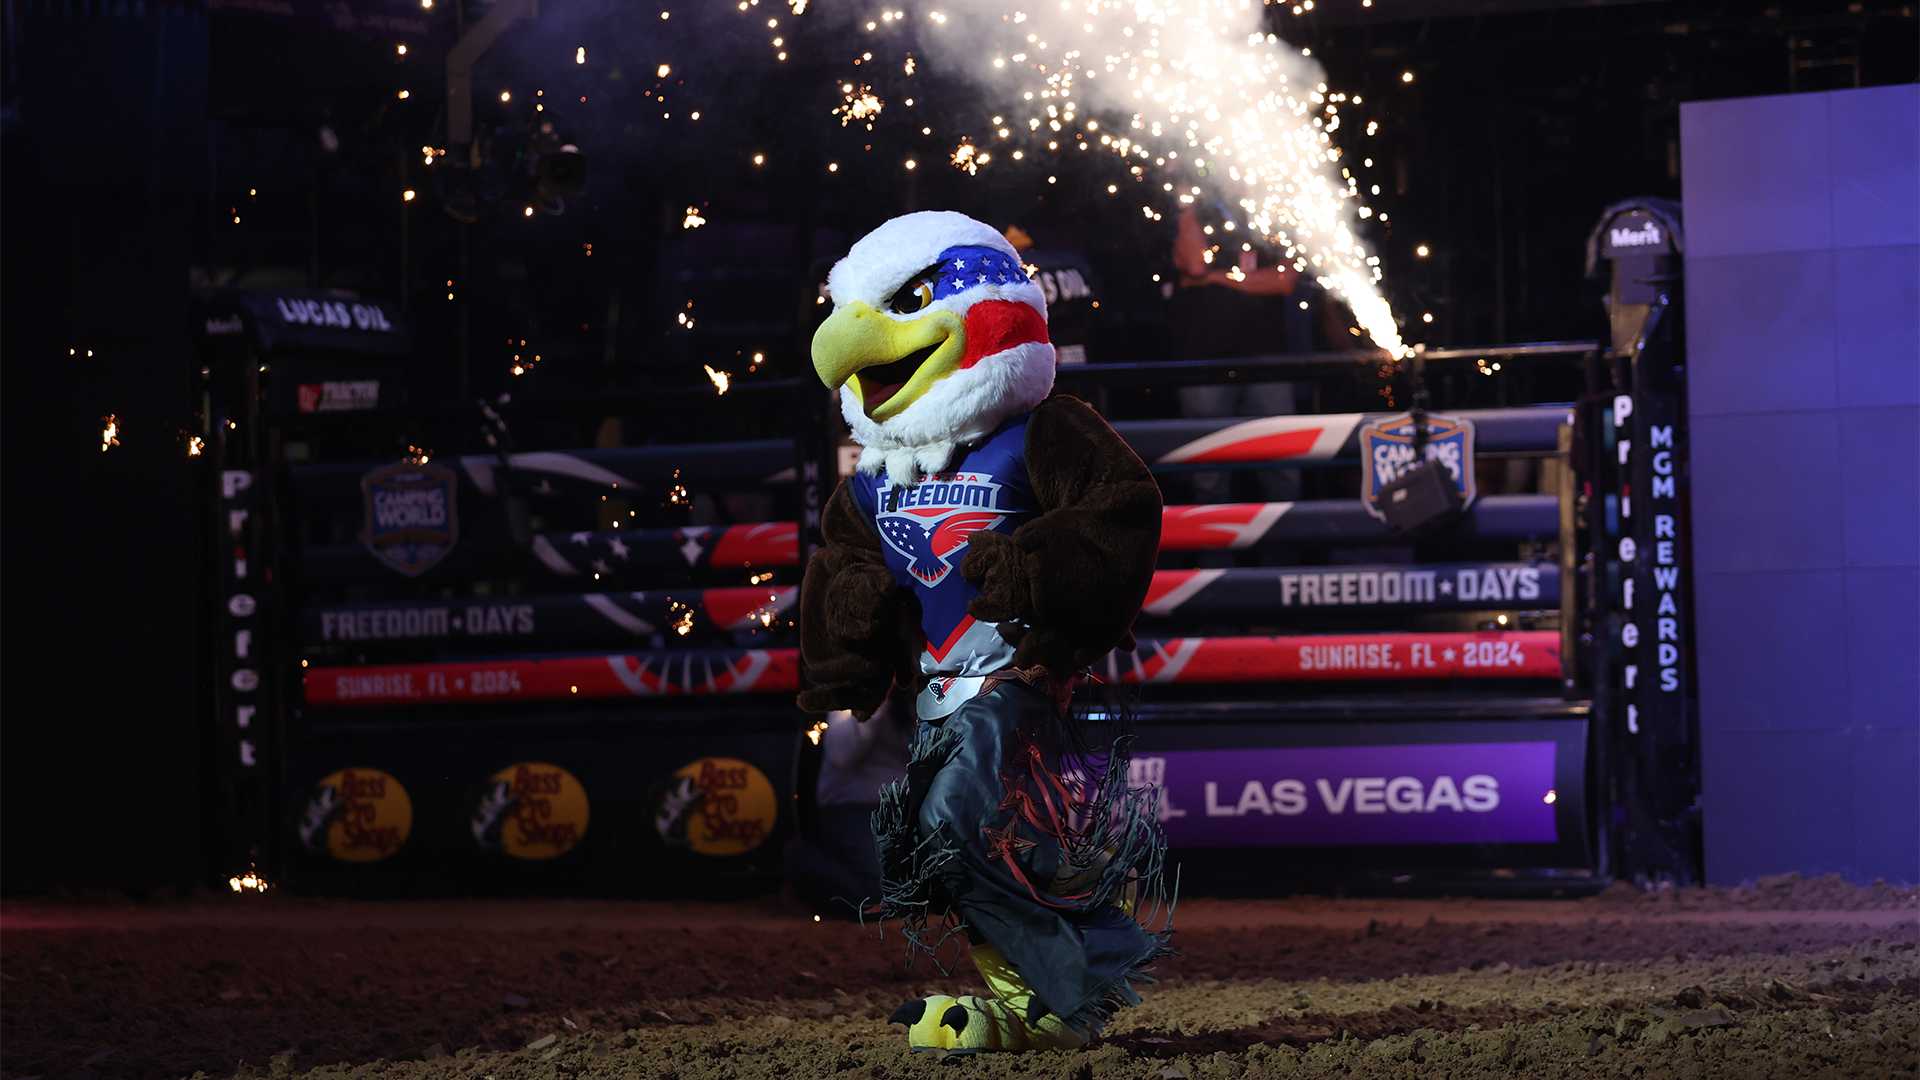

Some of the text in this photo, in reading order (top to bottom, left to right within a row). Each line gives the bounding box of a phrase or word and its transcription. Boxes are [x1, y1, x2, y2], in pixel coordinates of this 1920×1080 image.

[1611, 220, 1660, 247] Merit
[276, 296, 391, 332] LUCAS OIL
[1613, 394, 1640, 735] Priefert
[1650, 424, 1680, 692] MGM REWARDS
[1279, 567, 1541, 607] FREEDOM DAYS
[220, 469, 259, 766] Priefert
[321, 604, 535, 641] FREEDOM DAYS
[1299, 641, 1526, 672] SUNRISE, FL 2024
[426, 671, 449, 697] FL
[469, 670, 523, 696] 2024
[1204, 778, 1304, 818] LAS
[1314, 774, 1500, 815] VEGAS
